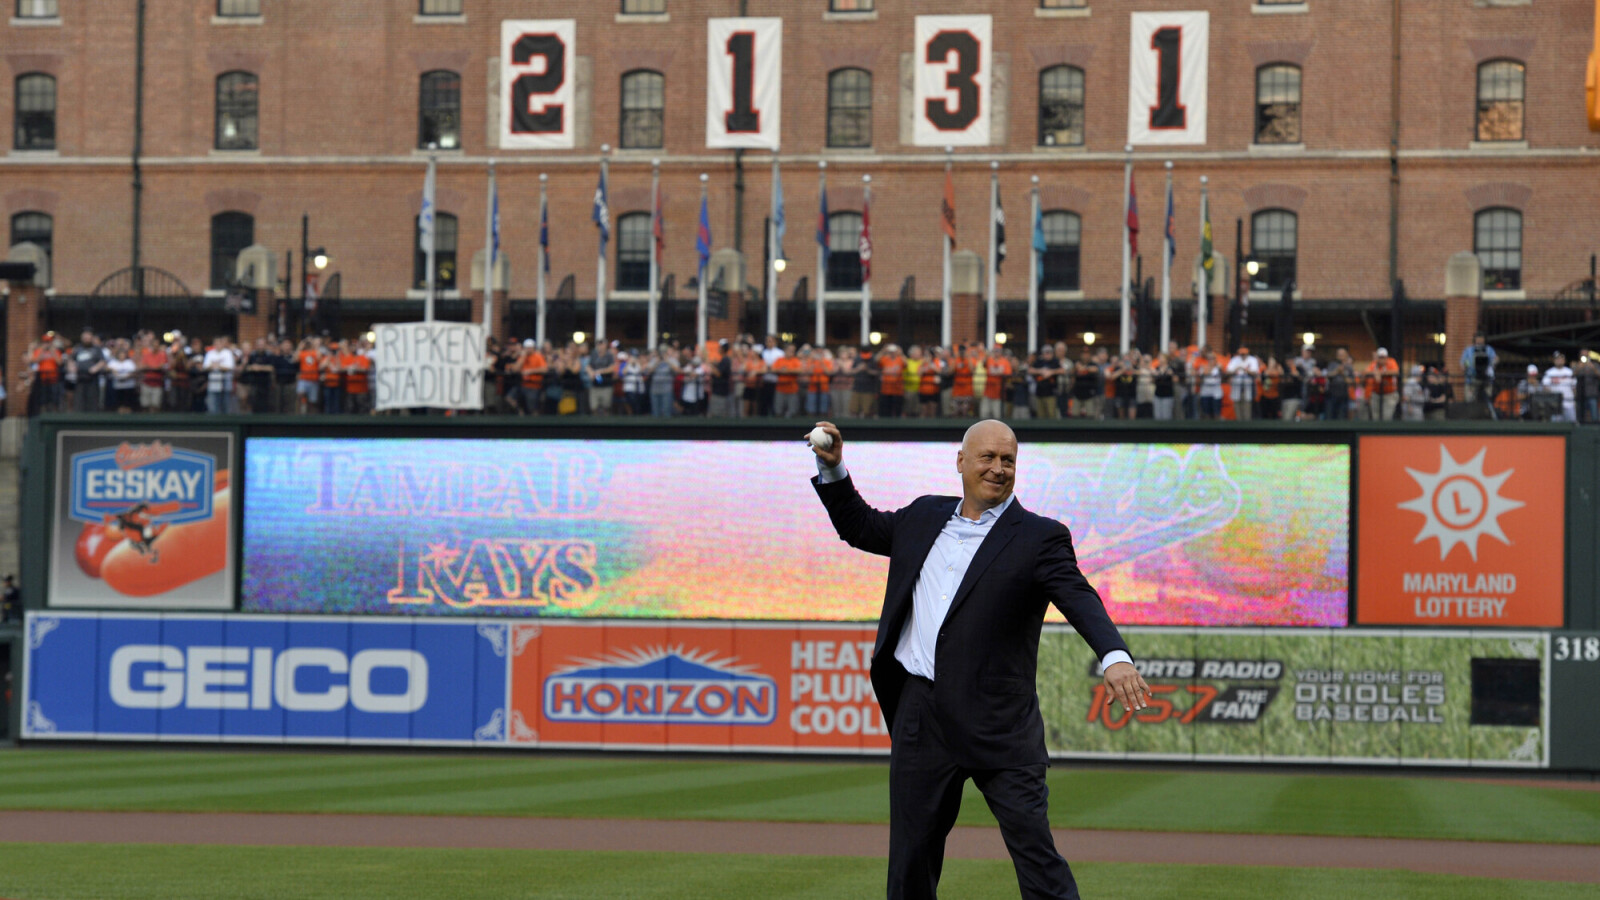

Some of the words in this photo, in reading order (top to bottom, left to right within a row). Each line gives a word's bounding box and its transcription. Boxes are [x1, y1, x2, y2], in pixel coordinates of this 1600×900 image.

[511, 33, 565, 134] 2
[725, 31, 760, 133] 1
[925, 29, 981, 132] 3
[1149, 26, 1188, 131] 1
[382, 325, 482, 364] RIPKEN
[378, 365, 484, 404] STADIUM
[86, 469, 202, 500] ESSKAY
[387, 536, 602, 608] RAYS
[1403, 572, 1517, 594] MARYLAND
[1415, 596, 1507, 618] LOTTERY
[791, 640, 875, 670] HEAT
[1554, 636, 1600, 661] 318
[109, 644, 429, 713] GEICO
[1096, 659, 1195, 678] ORTS
[1202, 661, 1282, 679] RADIO
[1296, 670, 1344, 683] YOUR
[1349, 671, 1401, 684] HOME
[1408, 671, 1444, 684] FOR
[551, 681, 769, 717] HORIZON
[791, 673, 879, 703] PLUM
[1236, 689, 1268, 703] THE
[1296, 684, 1445, 704] ORIOLES
[790, 705, 888, 735] COOL
[1087, 684, 1218, 731] 105.7
[1210, 701, 1260, 719] FAN
[1296, 704, 1444, 722] BASEBALL
